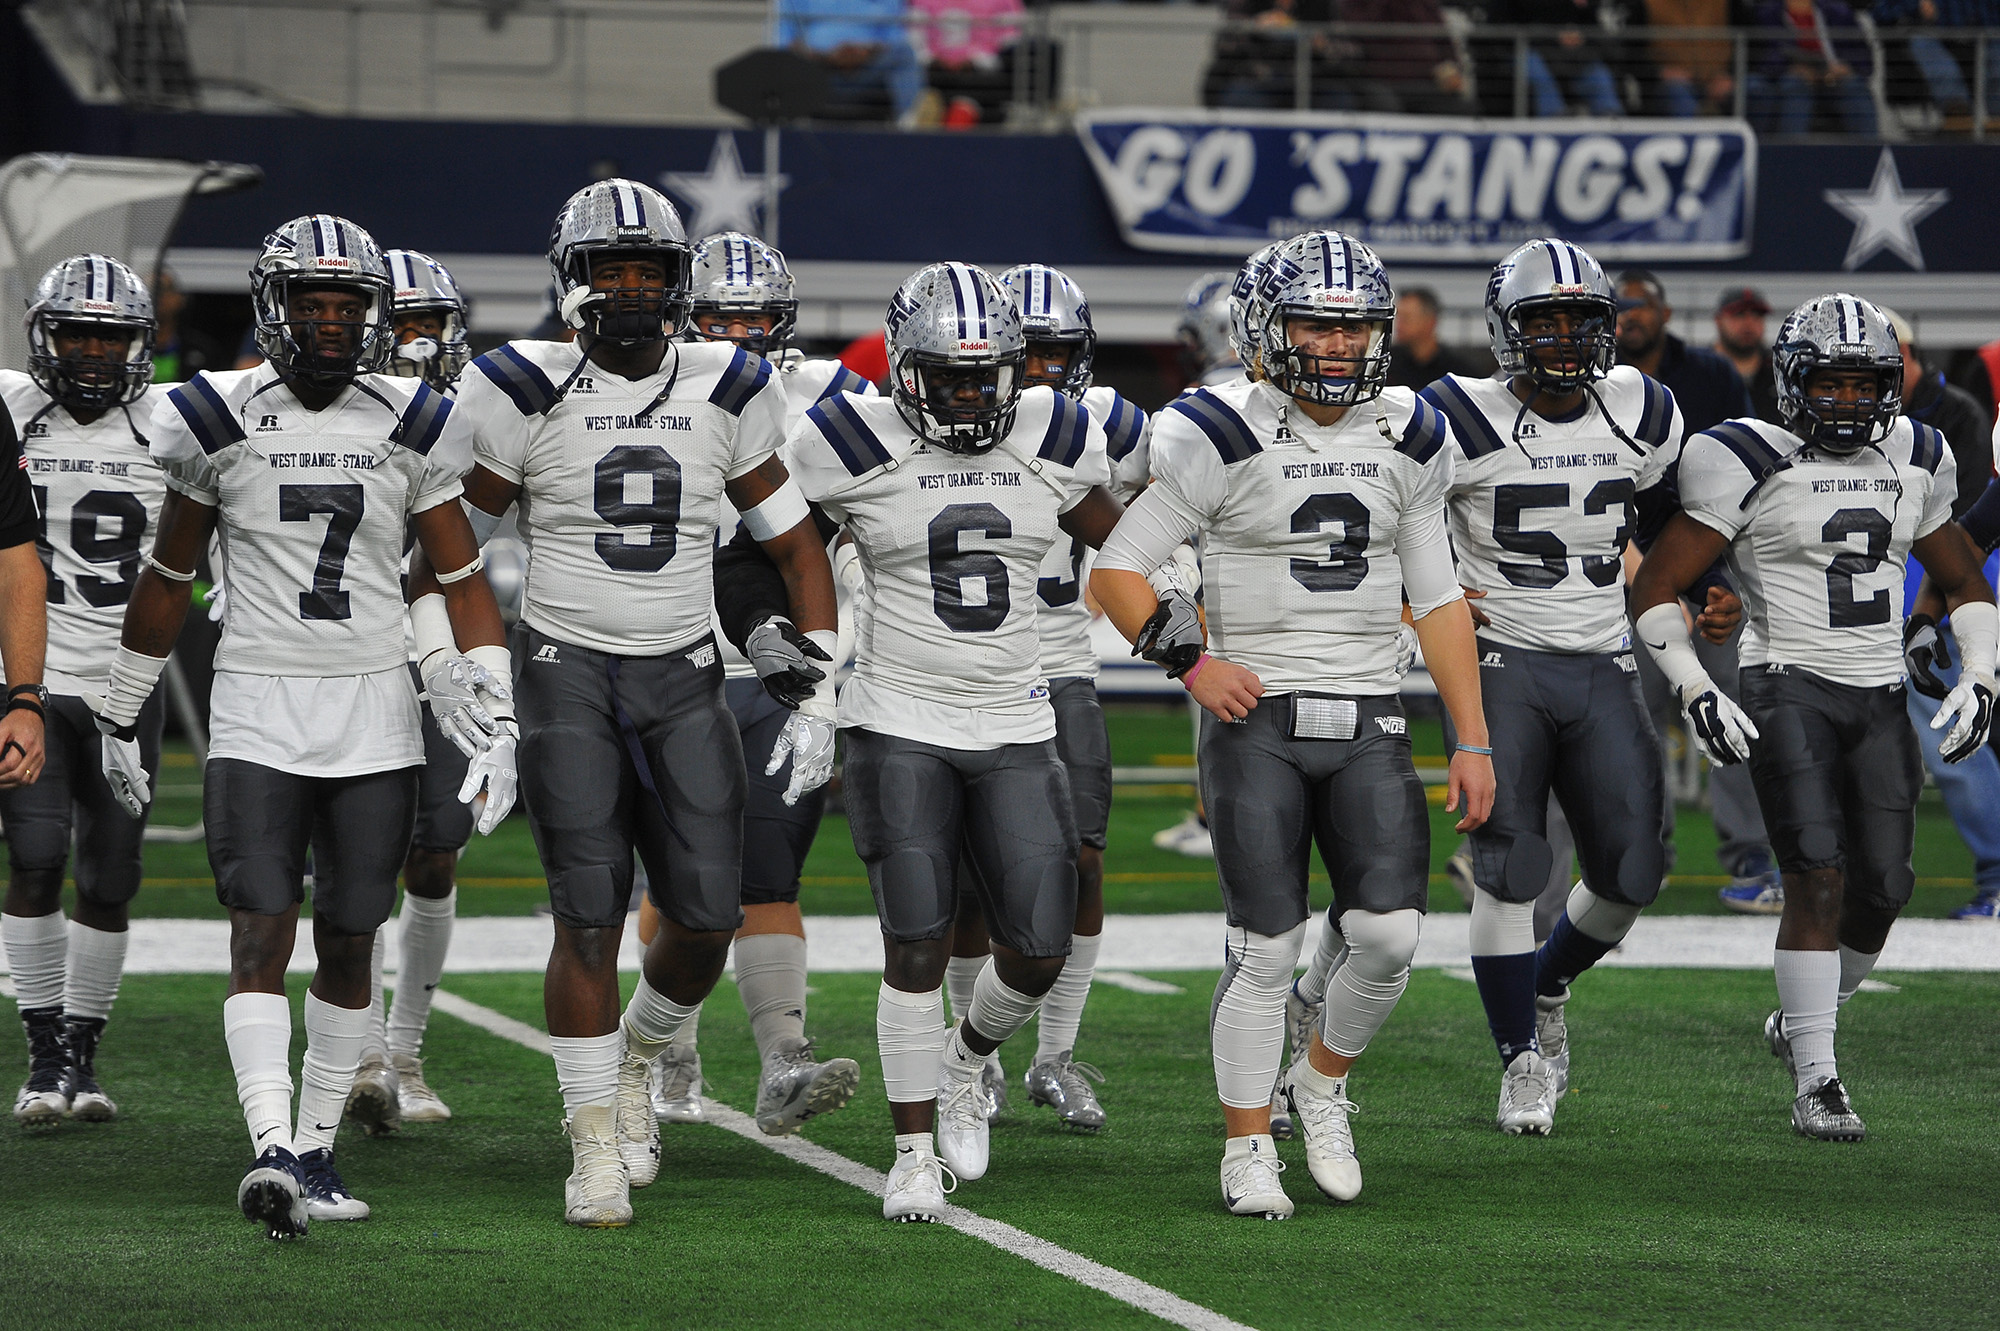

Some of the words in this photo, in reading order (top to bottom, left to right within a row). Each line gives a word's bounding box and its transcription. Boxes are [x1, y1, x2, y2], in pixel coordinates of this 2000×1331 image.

[1114, 126, 1257, 216] GO
[318, 258, 349, 268] Riddell
[1326, 294, 1355, 304] Riddell
[960, 341, 988, 351] Riddell
[584, 415, 613, 431] WEST
[31, 458, 58, 472] WEST
[268, 453, 298, 469] WEST
[1530, 455, 1554, 471] WEST
[1281, 463, 1309, 479] WEST
[917, 474, 946, 490] WEST
[1811, 480, 1836, 493] WEST
[594, 445, 682, 573] 9
[1492, 477, 1637, 589] 53
[1290, 492, 1370, 592] 3
[279, 484, 364, 620] 7
[928, 502, 1012, 633] 6
[1821, 508, 1893, 628] 2
[531, 656, 562, 664] RUSSELL
